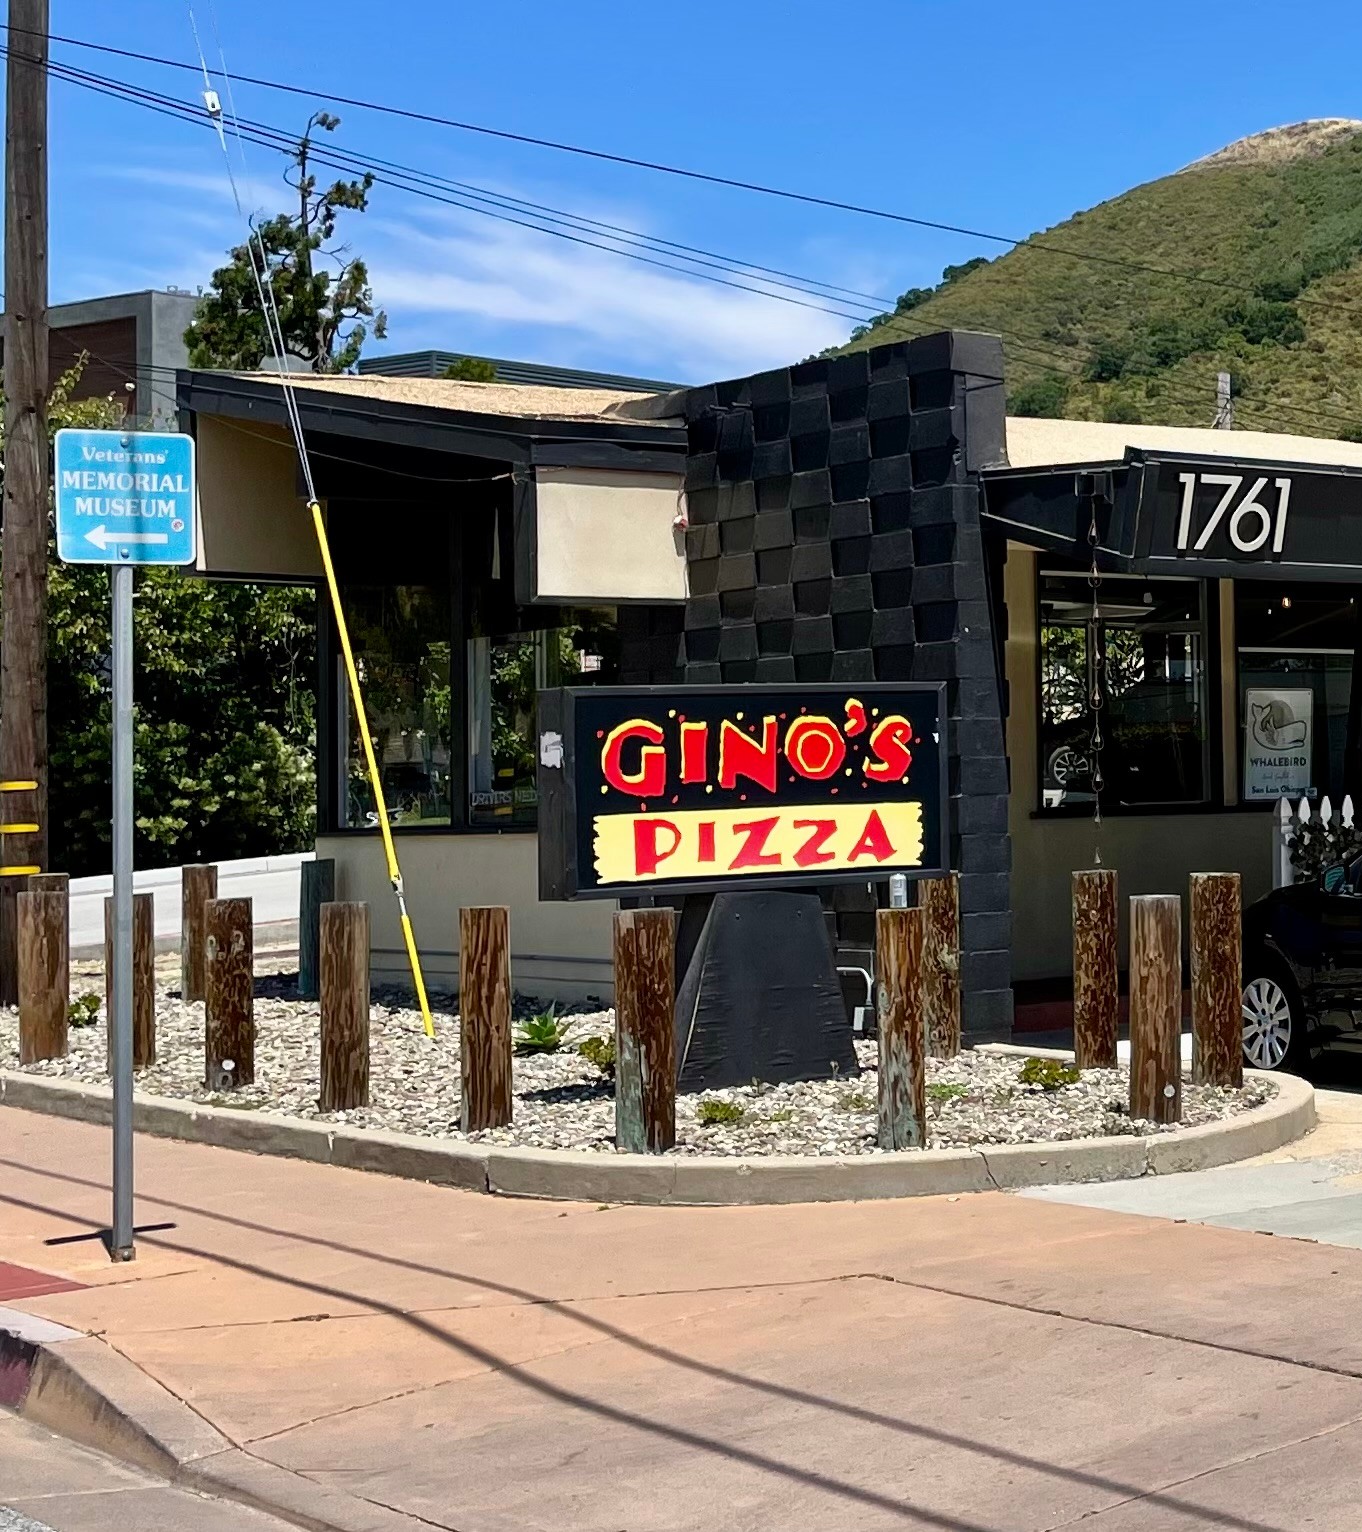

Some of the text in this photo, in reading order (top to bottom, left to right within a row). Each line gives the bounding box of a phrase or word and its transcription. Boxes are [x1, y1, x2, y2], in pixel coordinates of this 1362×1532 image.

[82, 446, 169, 464] Veterans'
[63, 471, 190, 493] MEMORIAL
[75, 497, 177, 518] MUSEUM
[1177, 472, 1292, 553] 1761
[601, 698, 912, 797] GINO'S
[1250, 757, 1307, 767] WHALEBIRD
[633, 809, 898, 876] PIZZA
